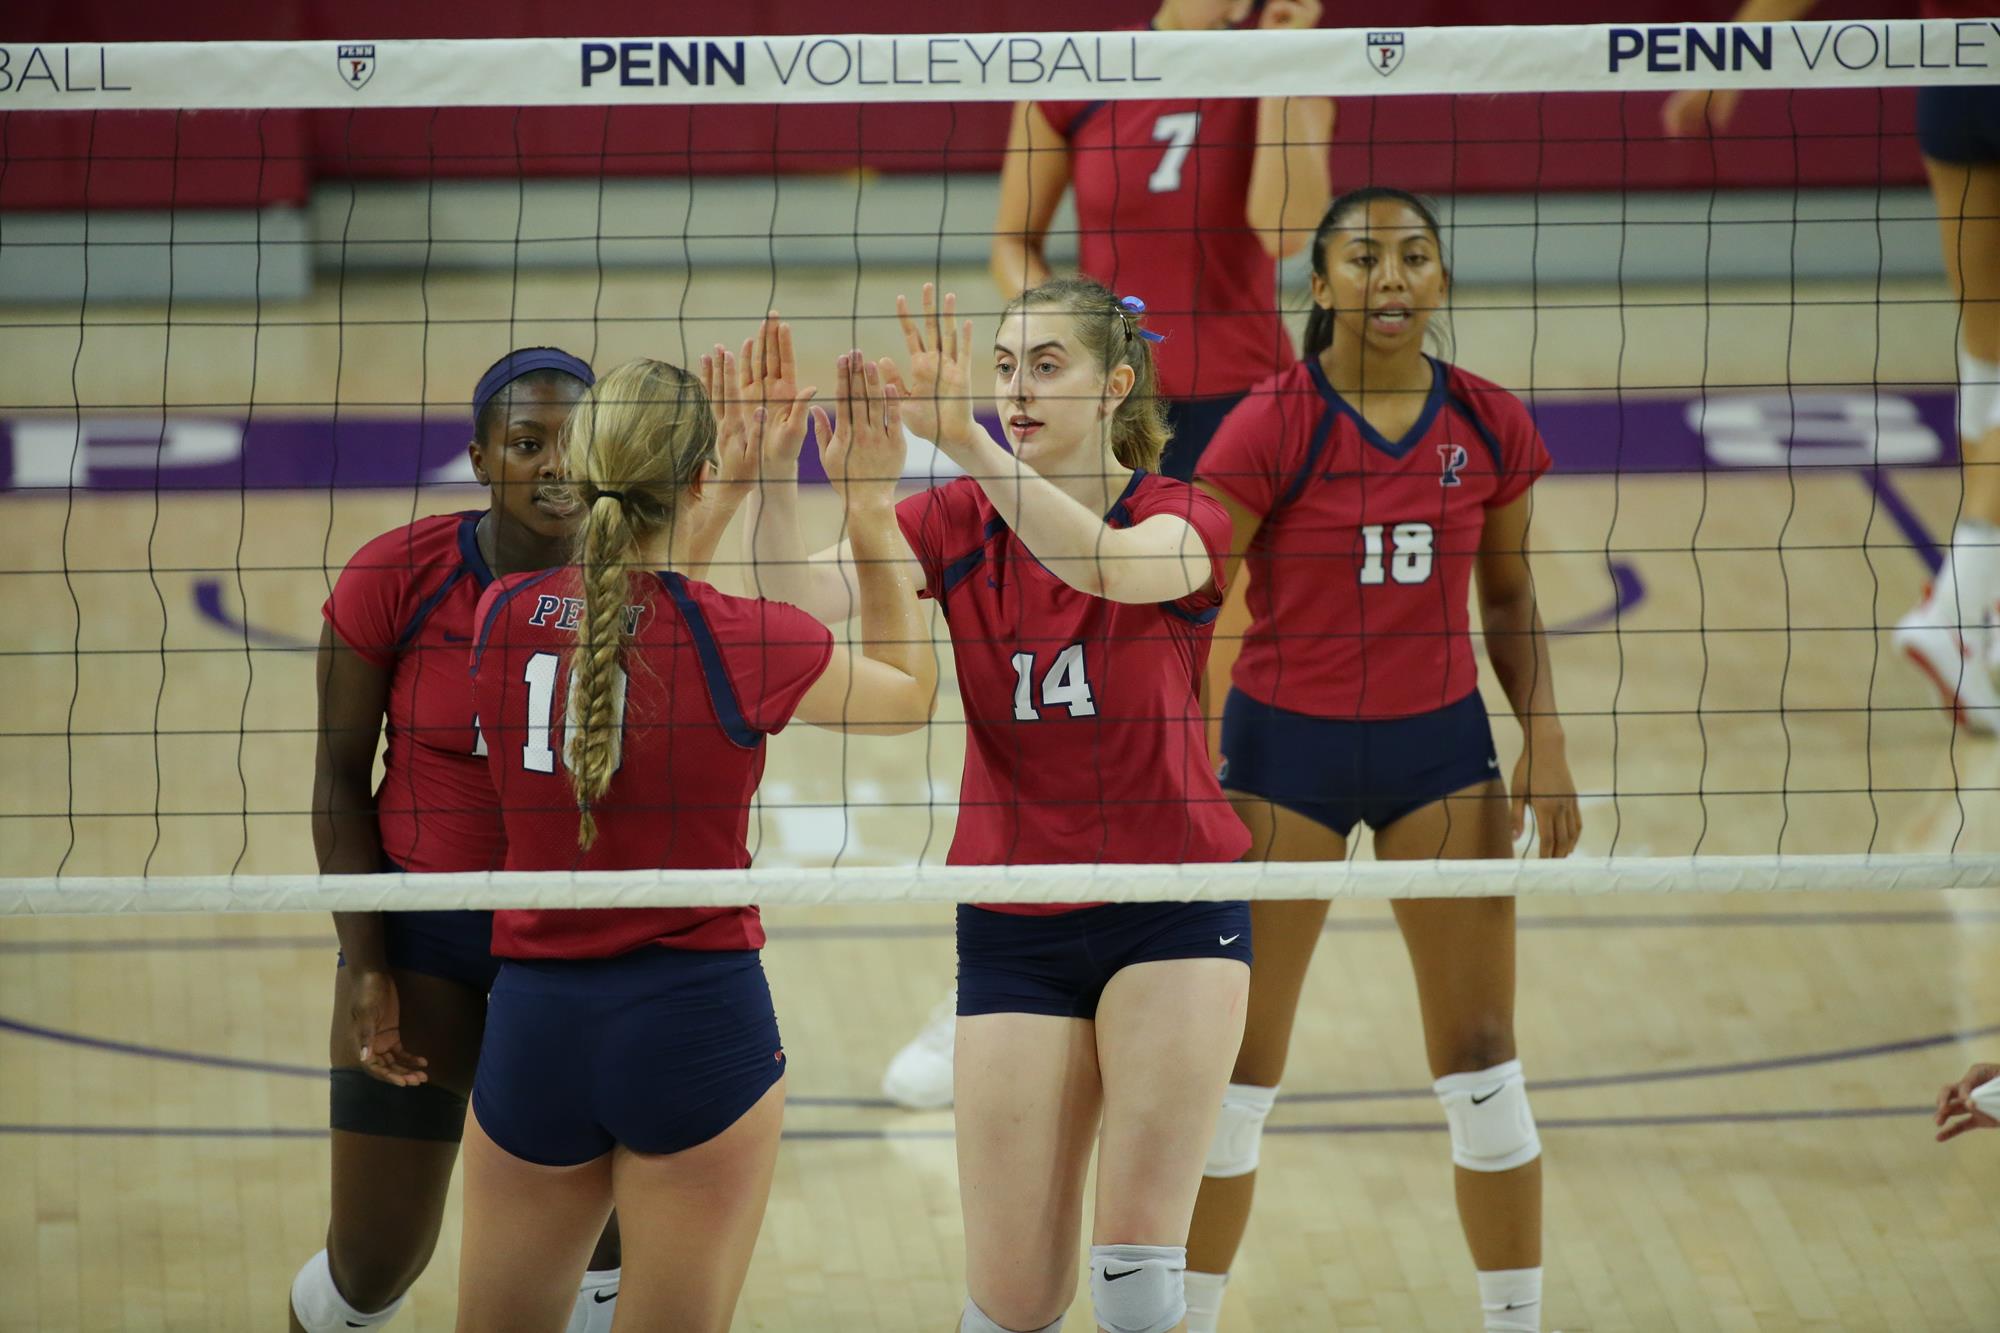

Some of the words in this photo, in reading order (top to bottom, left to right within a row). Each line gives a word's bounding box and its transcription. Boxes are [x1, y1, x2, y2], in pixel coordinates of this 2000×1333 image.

[581, 41, 745, 87] PENN
[763, 36, 1162, 86] VOLLEYBALL
[1608, 26, 1772, 73] PENN
[1790, 22, 2000, 70] VOLLE
[1148, 110, 1203, 194] 7
[1437, 444, 1468, 487] P
[1359, 521, 1435, 585] 18
[528, 594, 645, 636] PEN
[1010, 640, 1101, 722] 14
